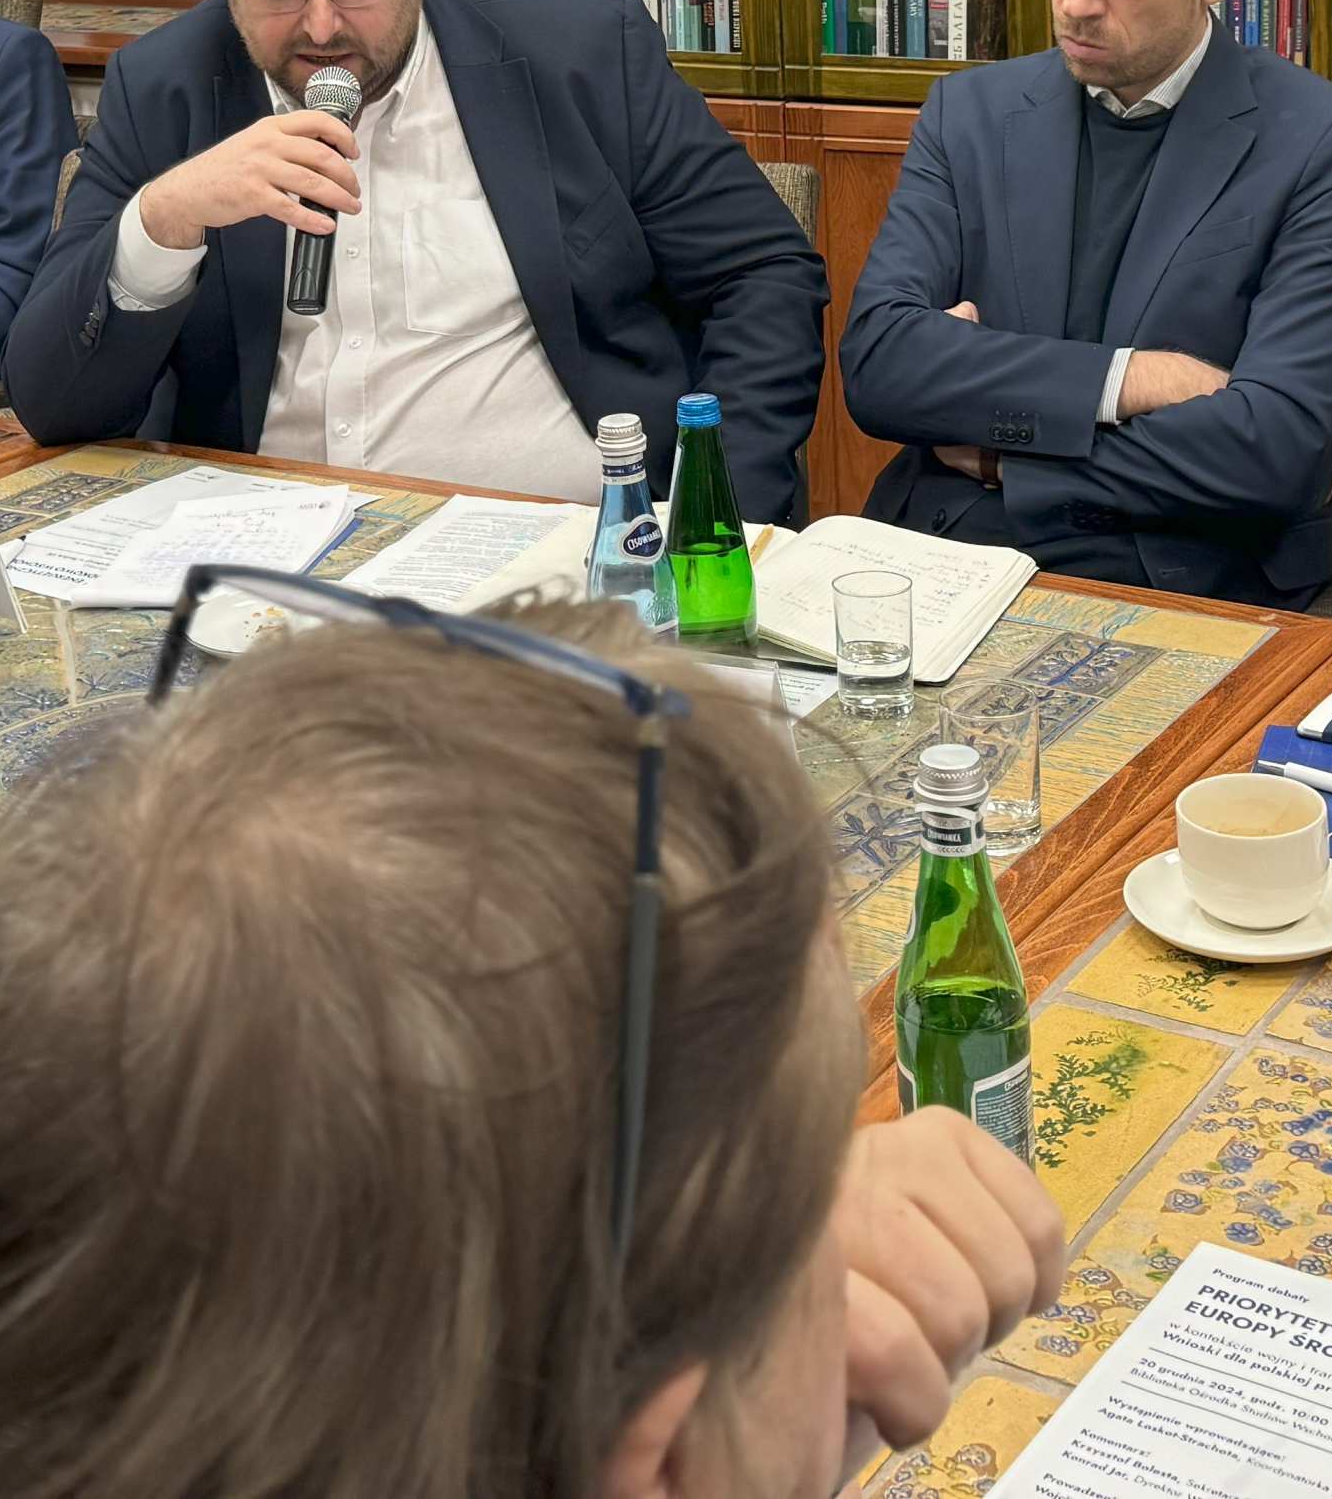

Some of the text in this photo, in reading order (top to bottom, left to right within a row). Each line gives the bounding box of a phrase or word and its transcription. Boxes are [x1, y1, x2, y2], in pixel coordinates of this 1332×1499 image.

[1212, 1268, 1310, 1303] Program debaty
[1184, 1300, 1285, 1340] EUROPY
[1163, 1330, 1222, 1356] Wnioski
[1223, 1351, 1248, 1366] dla
[1249, 1360, 1313, 1388] polskiej
[1258, 1350, 1298, 1370] wojny
[1138, 1357, 1157, 1370] 20
[1208, 1381, 1245, 1398] 2024,
[1291, 1408, 1331, 1428] 10:00
[1097, 1407, 1134, 1426] Agata
